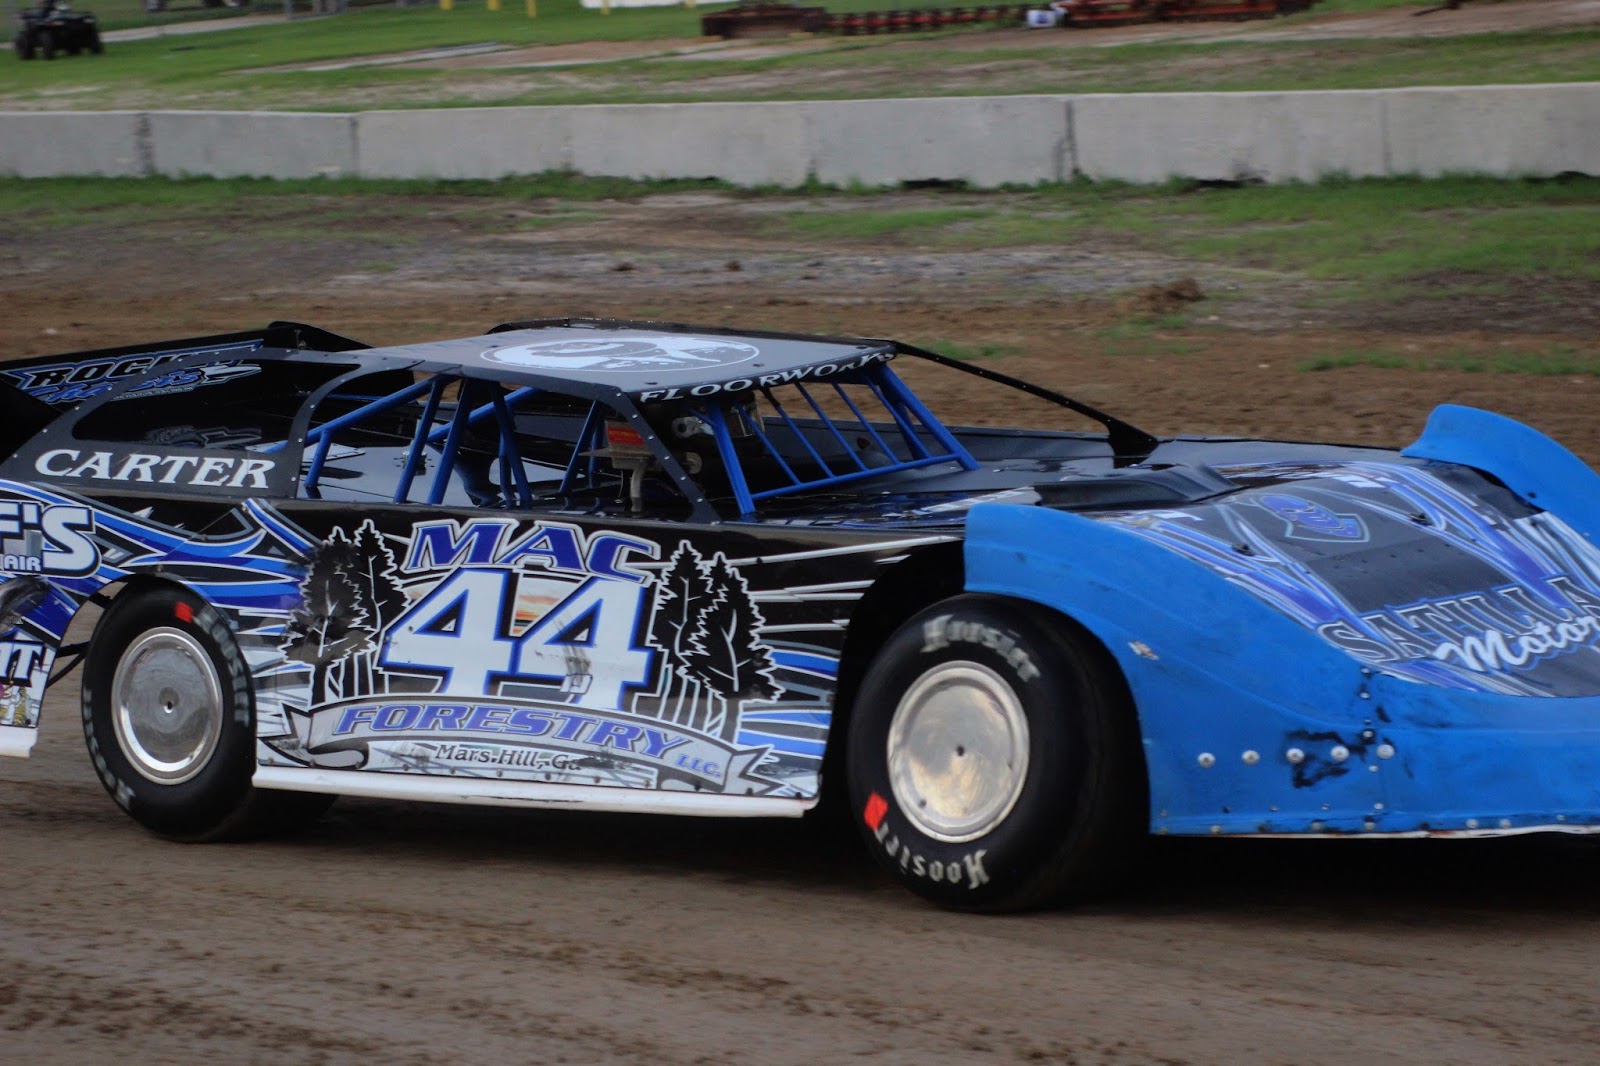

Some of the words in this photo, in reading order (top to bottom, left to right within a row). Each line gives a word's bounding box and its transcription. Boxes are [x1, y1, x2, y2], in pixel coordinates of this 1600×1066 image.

[35, 448, 276, 490] CARTER
[0, 554, 42, 572] AIR
[402, 519, 661, 588] MAC
[382, 567, 655, 711] 44
[332, 703, 694, 758] FORESTRY
